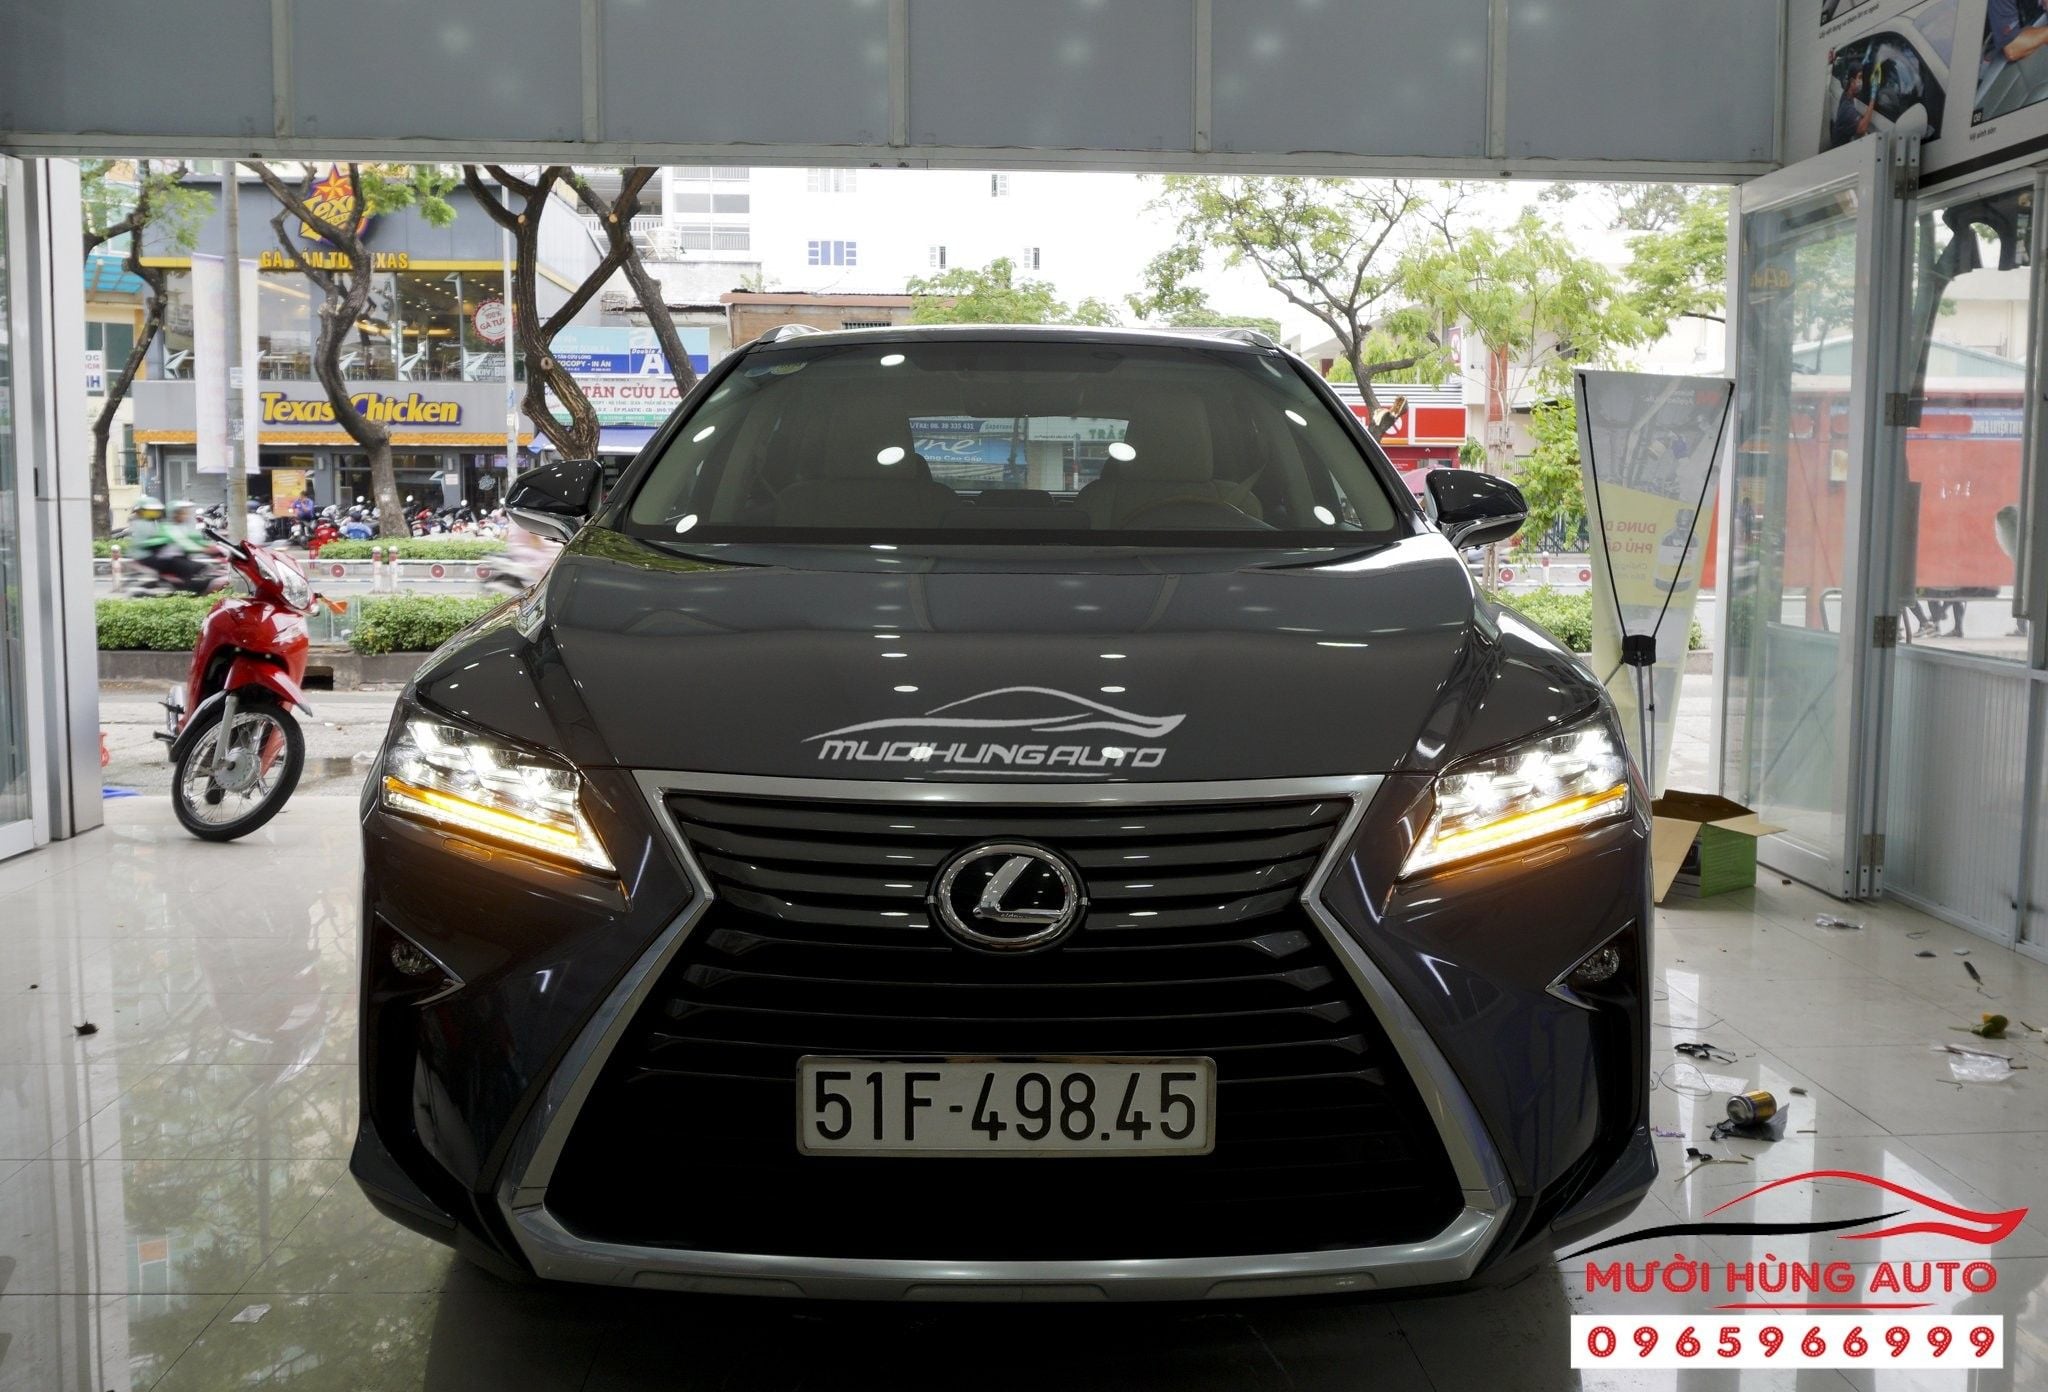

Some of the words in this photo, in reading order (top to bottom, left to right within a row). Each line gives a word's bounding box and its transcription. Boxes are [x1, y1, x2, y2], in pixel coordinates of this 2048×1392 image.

[620, 383, 655, 399] CỬU
[260, 392, 335, 422] Texas
[349, 393, 460, 425] Chicken
[815, 1071, 1197, 1141] 51F-498.45
